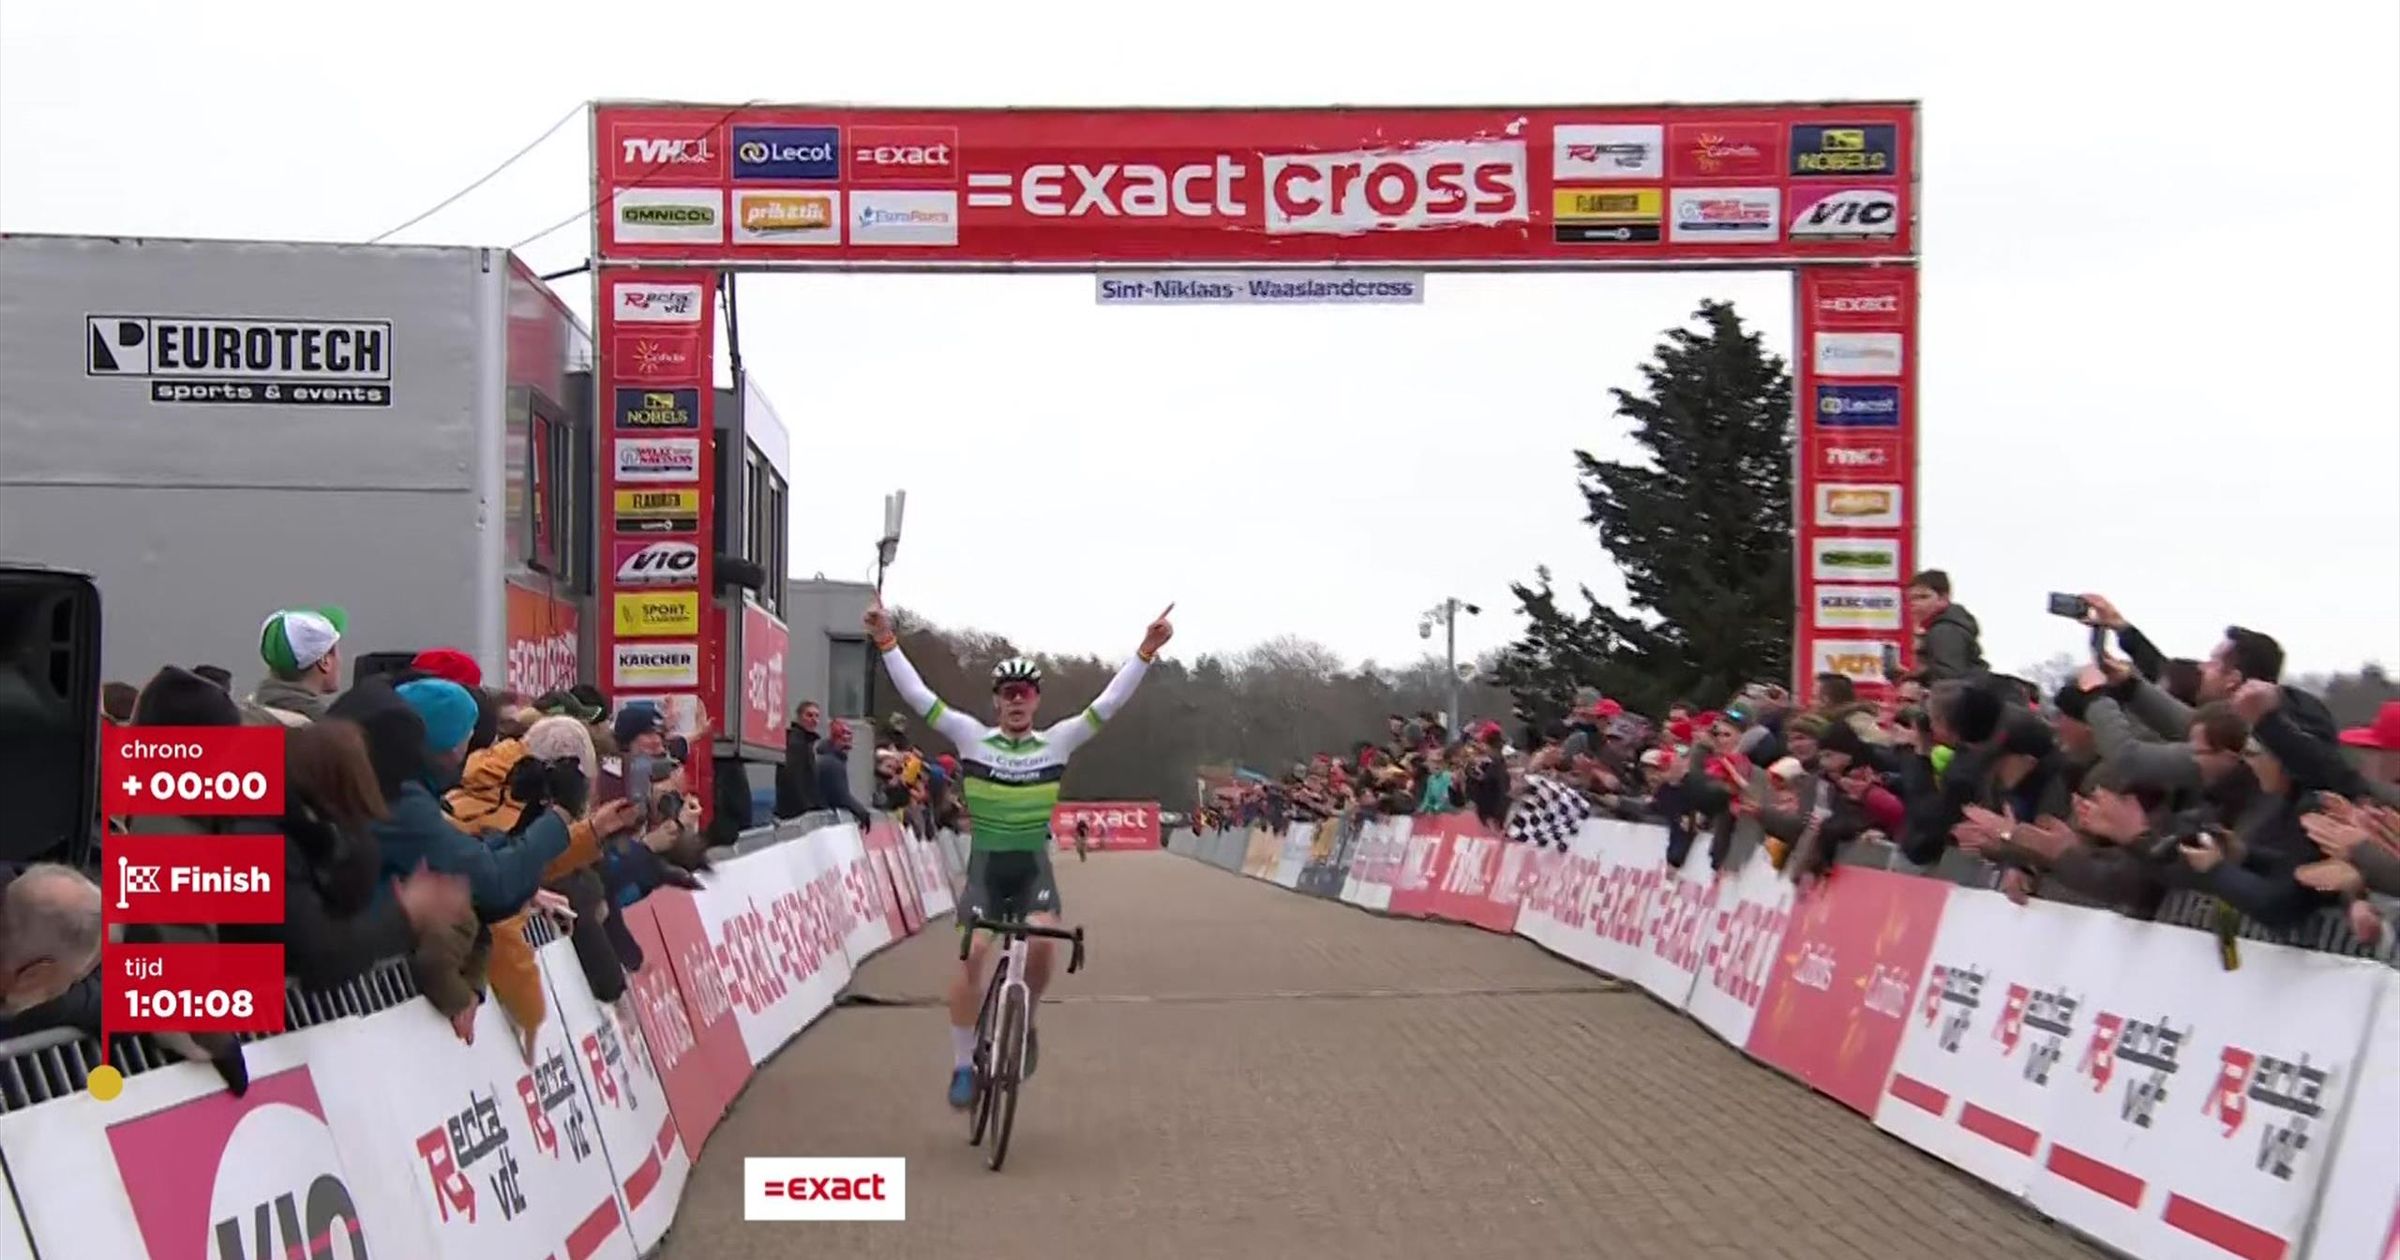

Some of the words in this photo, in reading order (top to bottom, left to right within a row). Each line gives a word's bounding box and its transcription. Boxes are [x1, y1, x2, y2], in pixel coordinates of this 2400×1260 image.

[771, 143, 833, 161] Lecot
[1273, 161, 1516, 218] cross
[625, 208, 711, 222] OMNICOL
[1808, 201, 1892, 225] VIO
[1249, 279, 1415, 297] Waaslandcross
[157, 325, 381, 372] EUROTECH
[157, 384, 253, 401] sports
[265, 384, 281, 400] &
[293, 386, 383, 402] events
[627, 409, 688, 424] NOBELS
[632, 550, 696, 570] VIO
[416, 1089, 509, 1224] Recta
